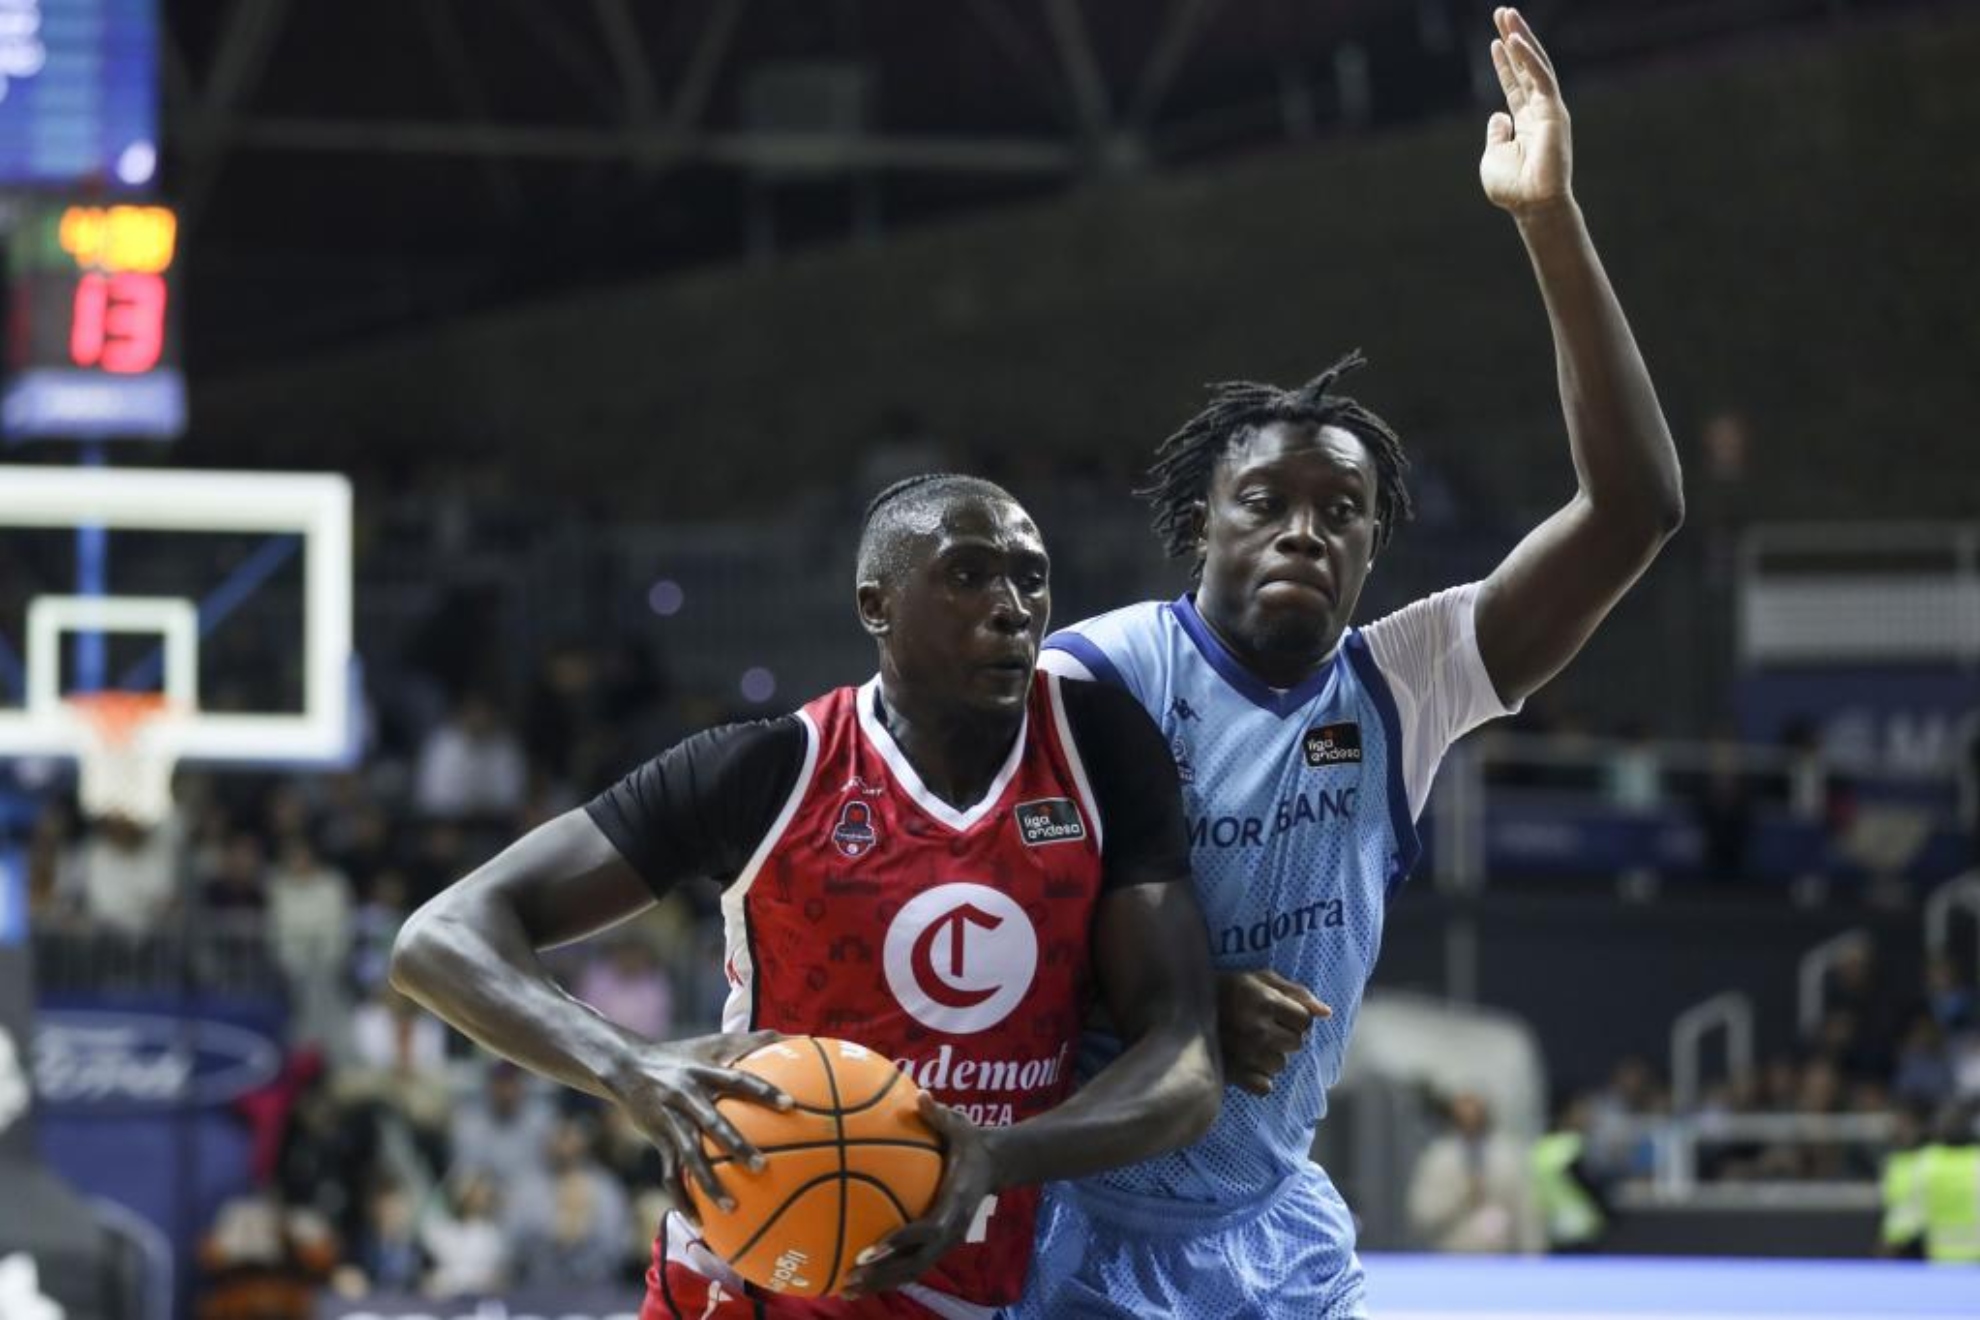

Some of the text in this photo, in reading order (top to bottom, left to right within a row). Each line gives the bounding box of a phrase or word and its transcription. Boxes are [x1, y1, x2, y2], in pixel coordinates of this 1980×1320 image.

[1024, 814, 1050, 828] liga
[1028, 824, 1080, 839] endesa
[1209, 899, 1344, 955] ndorra
